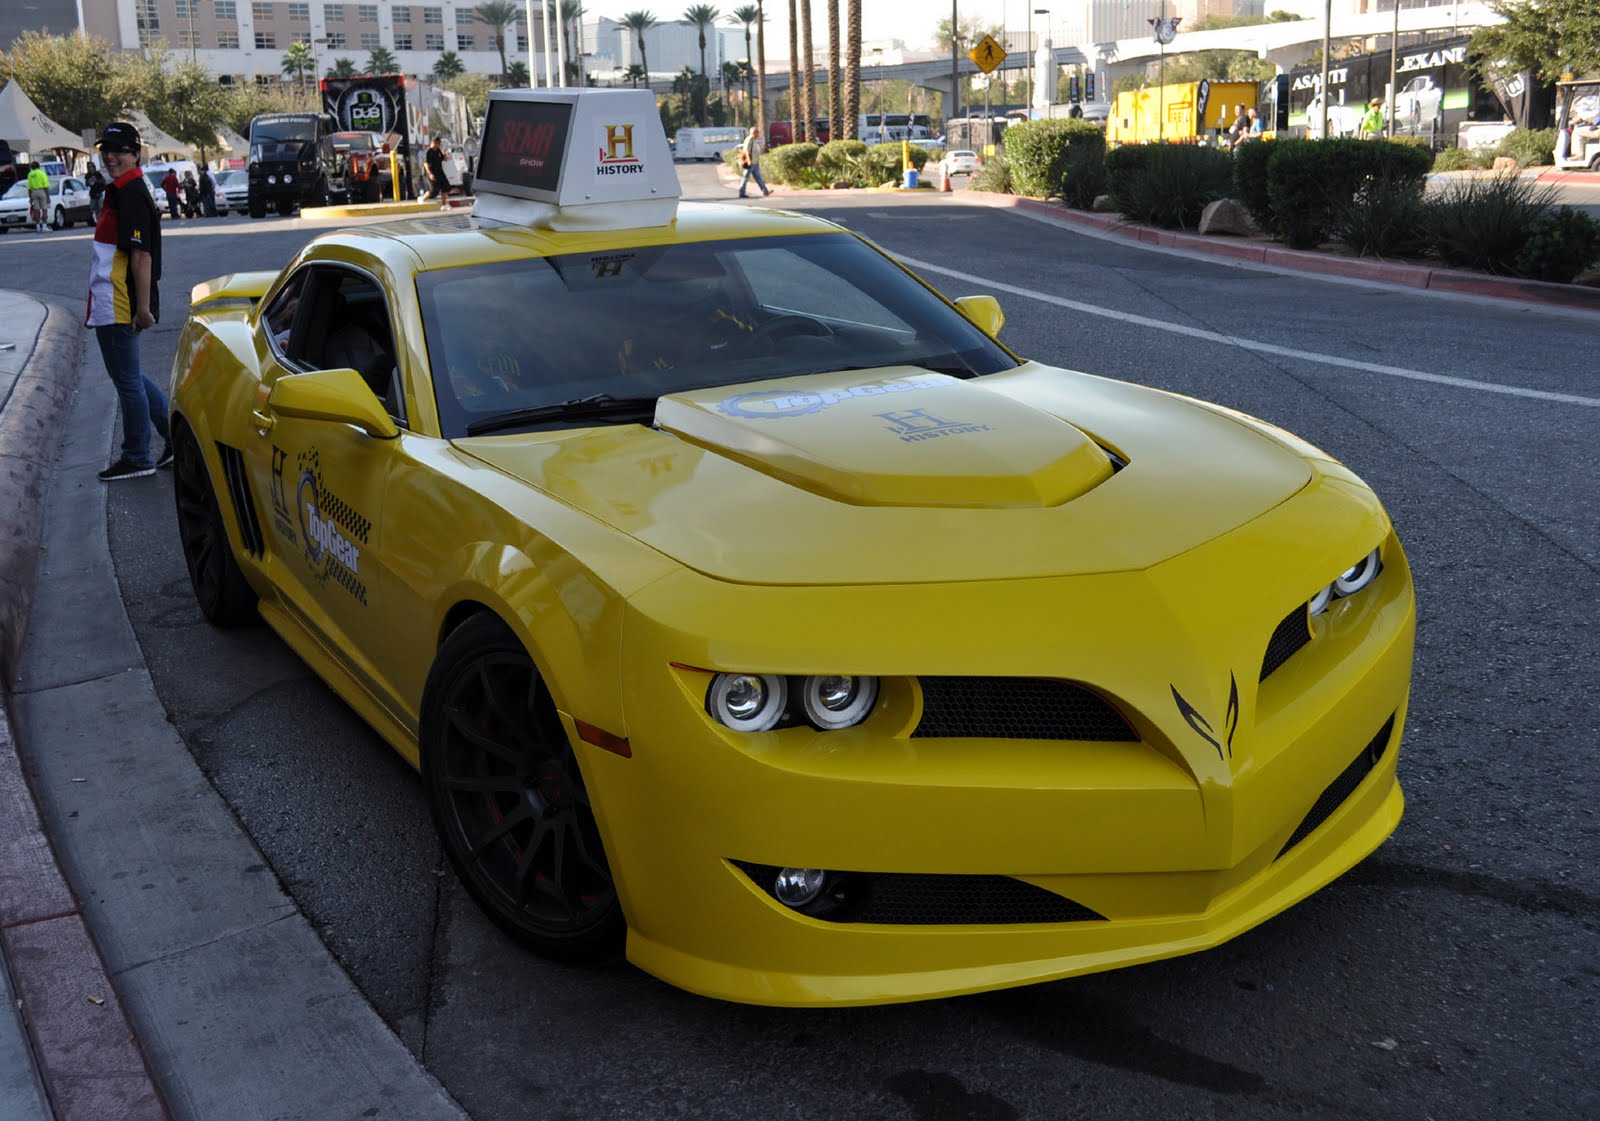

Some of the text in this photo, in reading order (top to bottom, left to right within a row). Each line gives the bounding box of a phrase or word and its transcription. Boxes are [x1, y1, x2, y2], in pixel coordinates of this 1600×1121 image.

[1396, 47, 1466, 73] EXANI
[353, 107, 380, 119] DUB
[498, 119, 556, 157] SEMA
[604, 124, 635, 159] H
[520, 157, 545, 168] SHOW
[597, 164, 644, 175] HISTORY
[900, 424, 991, 443] HISTORY
[306, 502, 361, 574] TopGear
